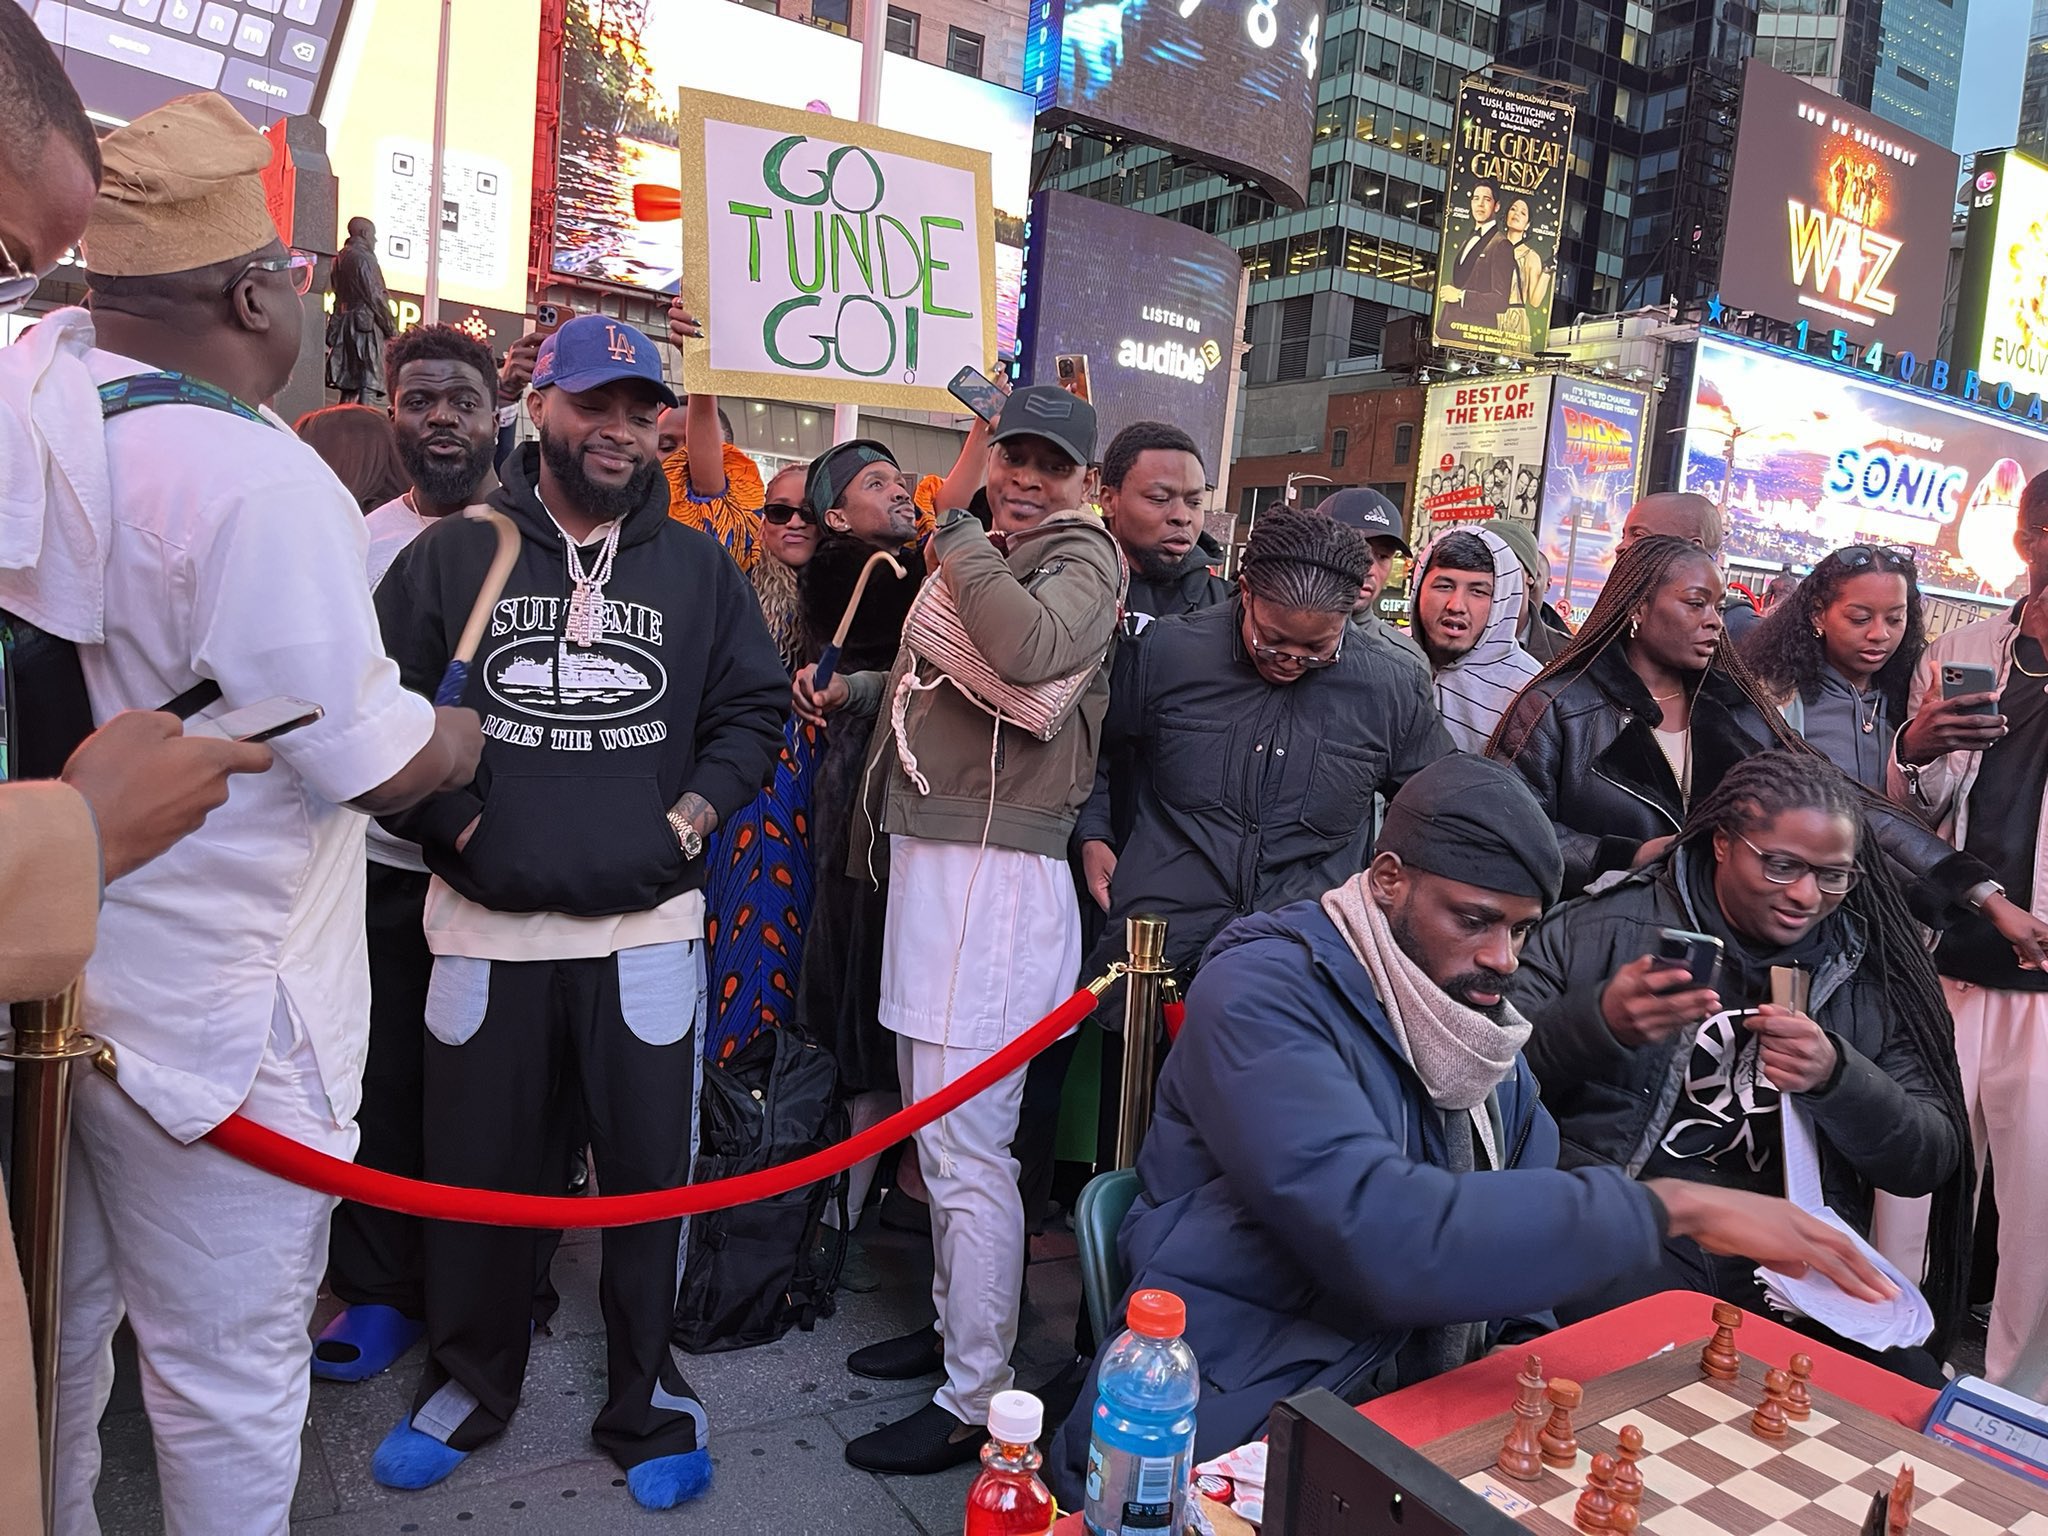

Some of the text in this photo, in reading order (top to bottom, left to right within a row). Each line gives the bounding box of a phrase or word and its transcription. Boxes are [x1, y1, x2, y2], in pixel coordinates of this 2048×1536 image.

[247, 77, 289, 99] return
[1488, 87, 1550, 106] NOW ON BROADWAY
[1491, 109, 1498, 119] &
[1505, 102, 1556, 121] BEWITCHING
[1463, 124, 1564, 168] THE GREAT
[763, 135, 885, 214] GO
[1471, 153, 1549, 190] GATSBY
[1974, 193, 1994, 208] LG
[729, 201, 973, 319] TUNDE
[1142, 305, 1200, 333] LISTEN ON
[763, 295, 919, 385] GO!
[1118, 339, 1206, 384] audible
[1455, 382, 1530, 406] BEST OF
[1562, 393, 1588, 406] MUSICAL
[1614, 404, 1639, 416] HISTORY
[1446, 402, 1535, 425] THE YEAR!
[1829, 448, 1963, 515] SONIC
[1364, 514, 1389, 526] adidas
[492, 597, 662, 646] SUPEME
[482, 714, 668, 751] RULES THE WORLD
